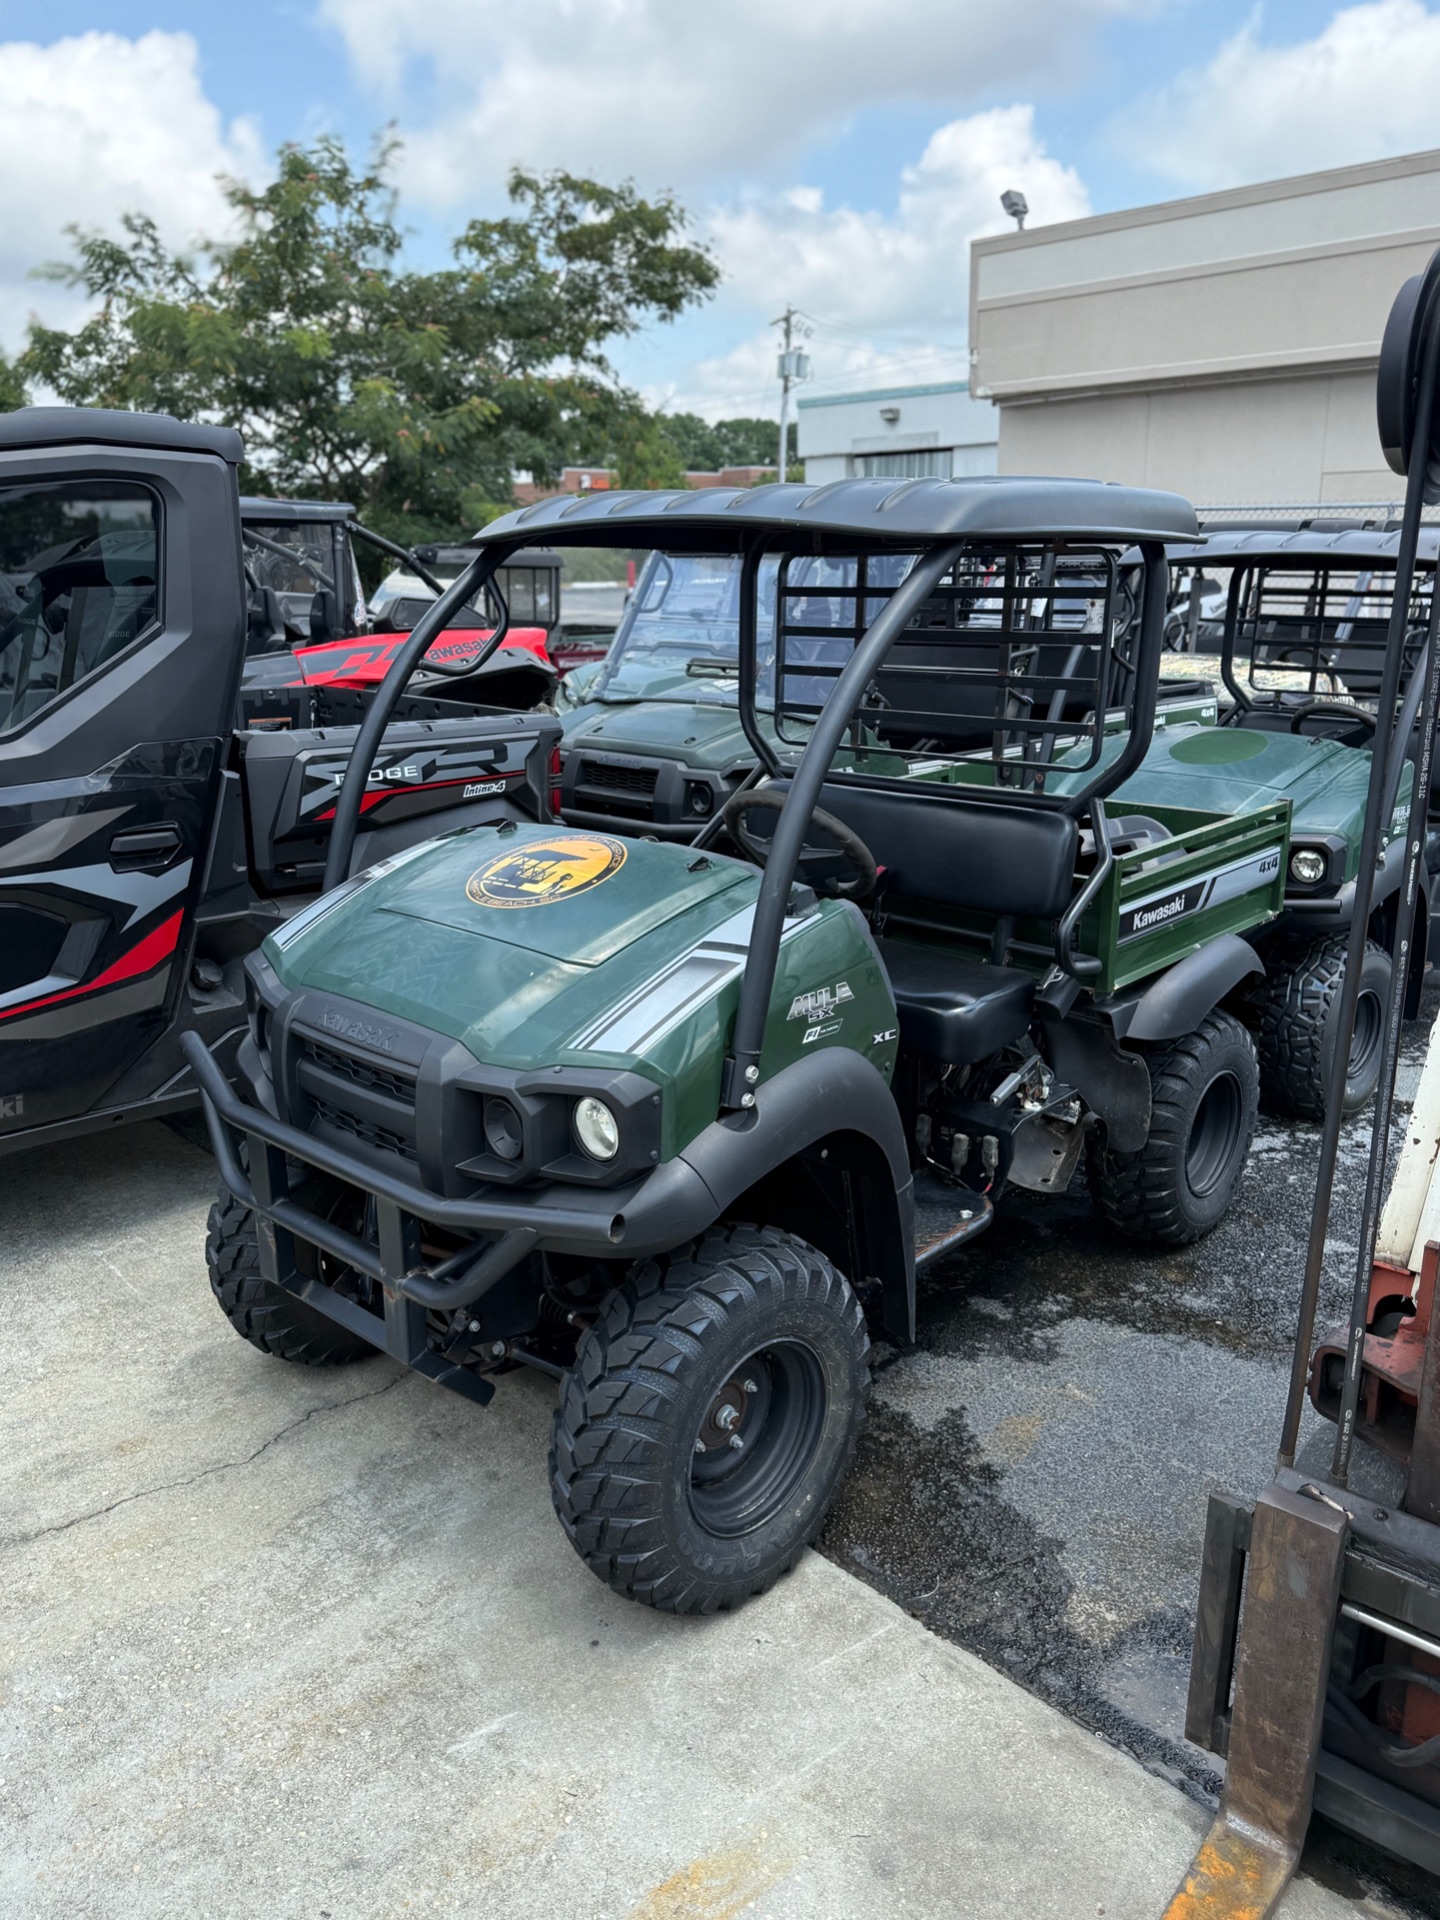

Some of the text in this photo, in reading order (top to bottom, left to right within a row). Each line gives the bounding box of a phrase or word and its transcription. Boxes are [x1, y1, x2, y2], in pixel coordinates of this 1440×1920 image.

[1200, 707, 1216, 718] 4x4
[1423, 717, 1434, 751] Resistant
[1421, 750, 1430, 771] MSHA
[333, 765, 418, 786] RDGE
[1258, 856, 1279, 874] 4x4
[1132, 893, 1186, 931] Kawasaki
[786, 981, 855, 1021] MULE
[807, 1003, 835, 1024] SX
[319, 1003, 403, 1054] Kawasaki
[872, 1028, 897, 1045] XC
